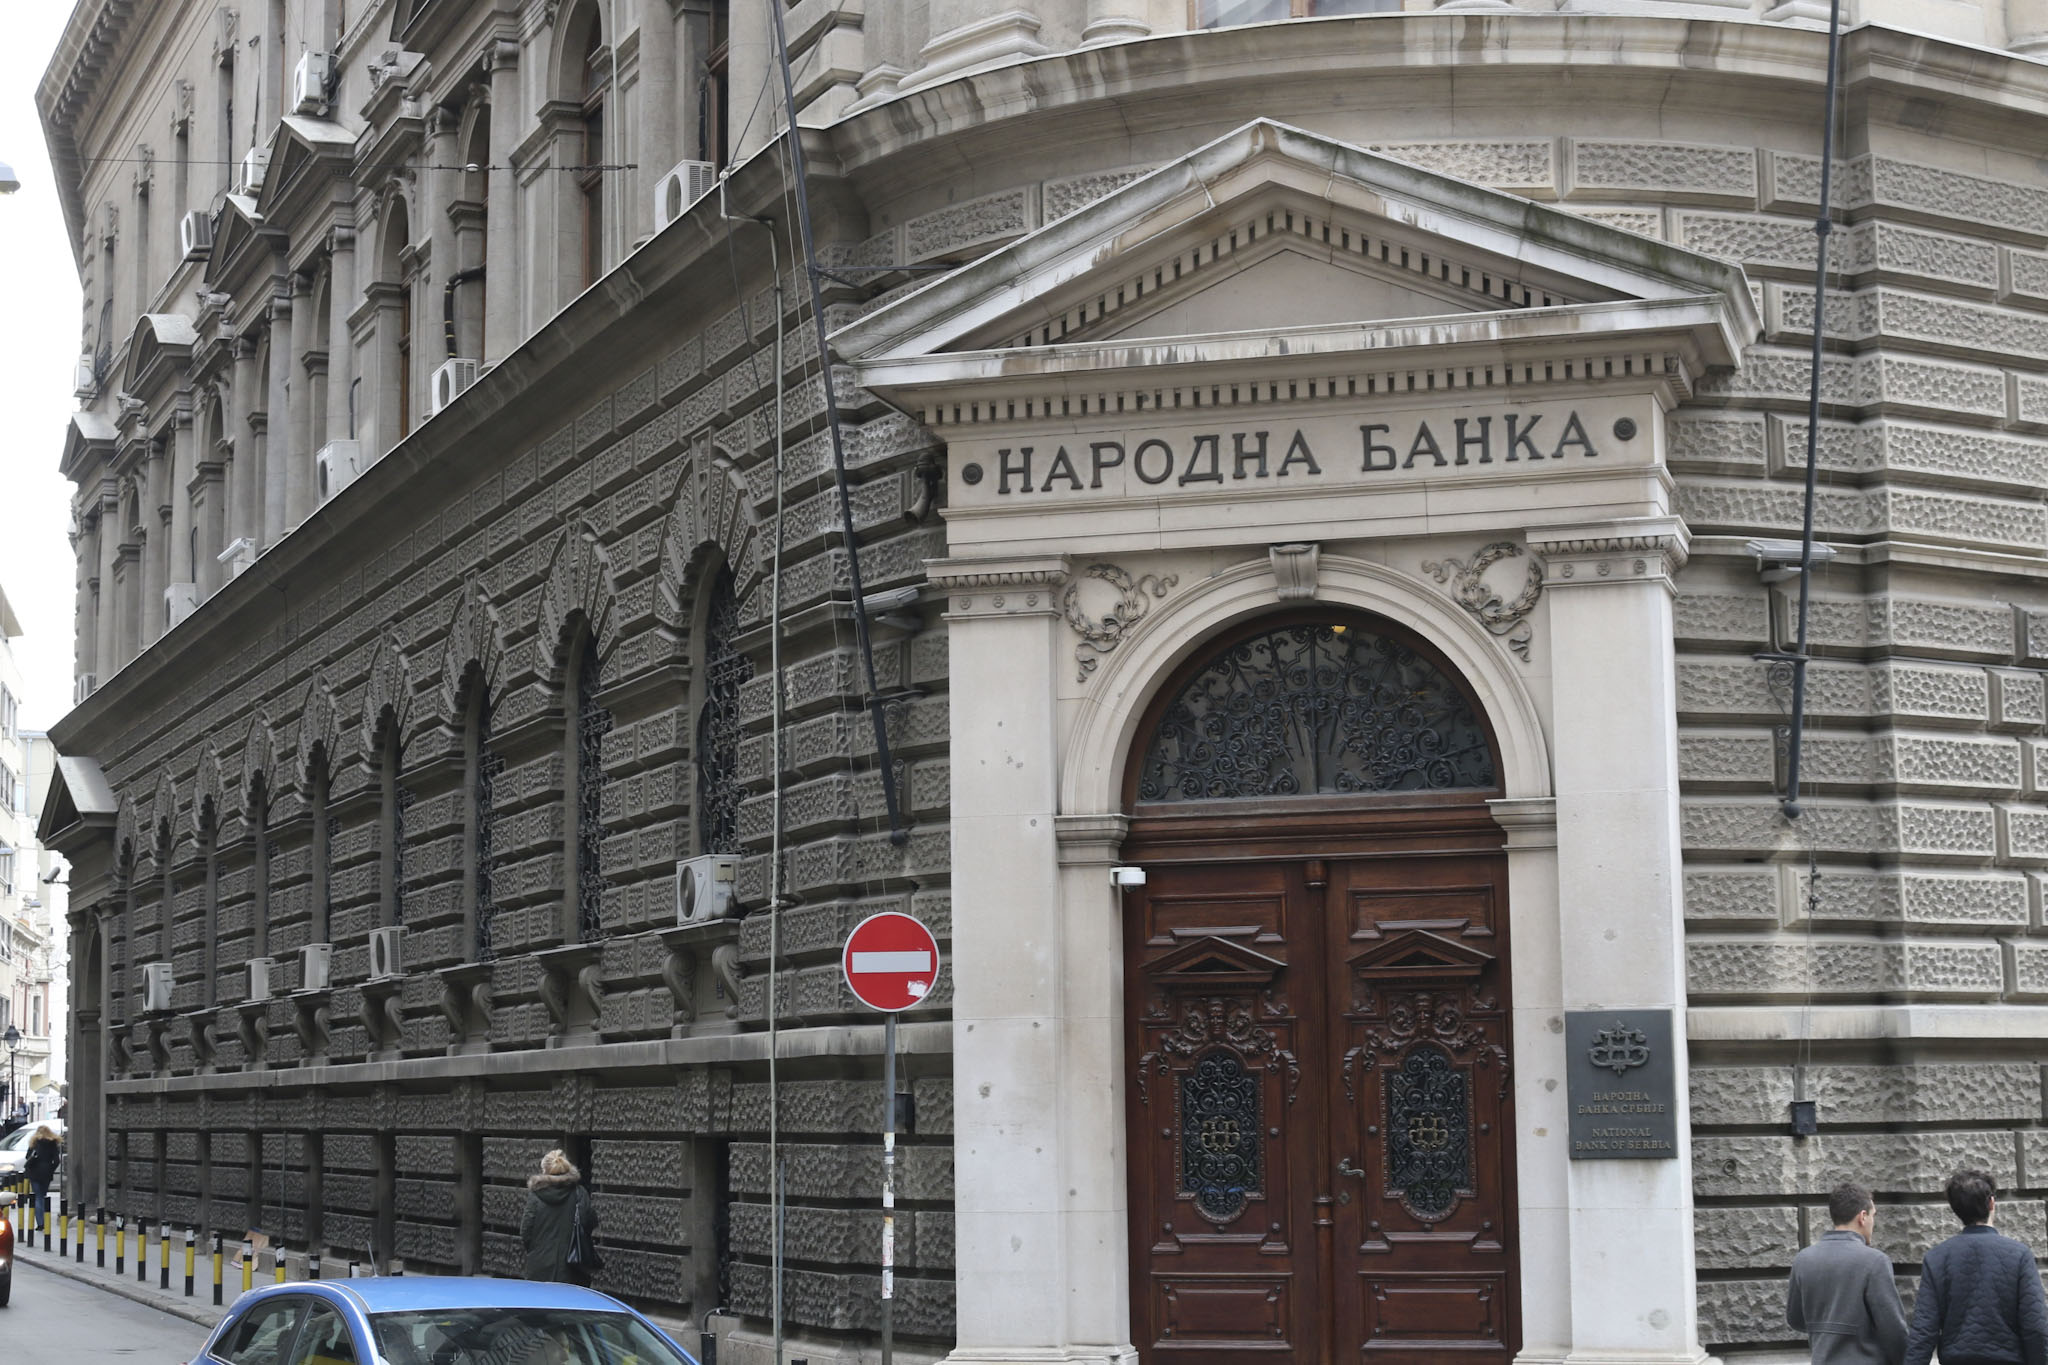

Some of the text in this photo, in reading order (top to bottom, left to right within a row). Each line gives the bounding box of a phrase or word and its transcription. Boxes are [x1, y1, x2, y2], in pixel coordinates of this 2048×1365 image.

[997, 410, 1599, 495] НАРОДНА БАНКА
[1593, 1091, 1650, 1102] НАРОДНА
[1578, 1104, 1618, 1114] БАНКА
[1592, 1127, 1652, 1137] NATIONAL
[1575, 1139, 1672, 1151] BANK OF SERBIA
